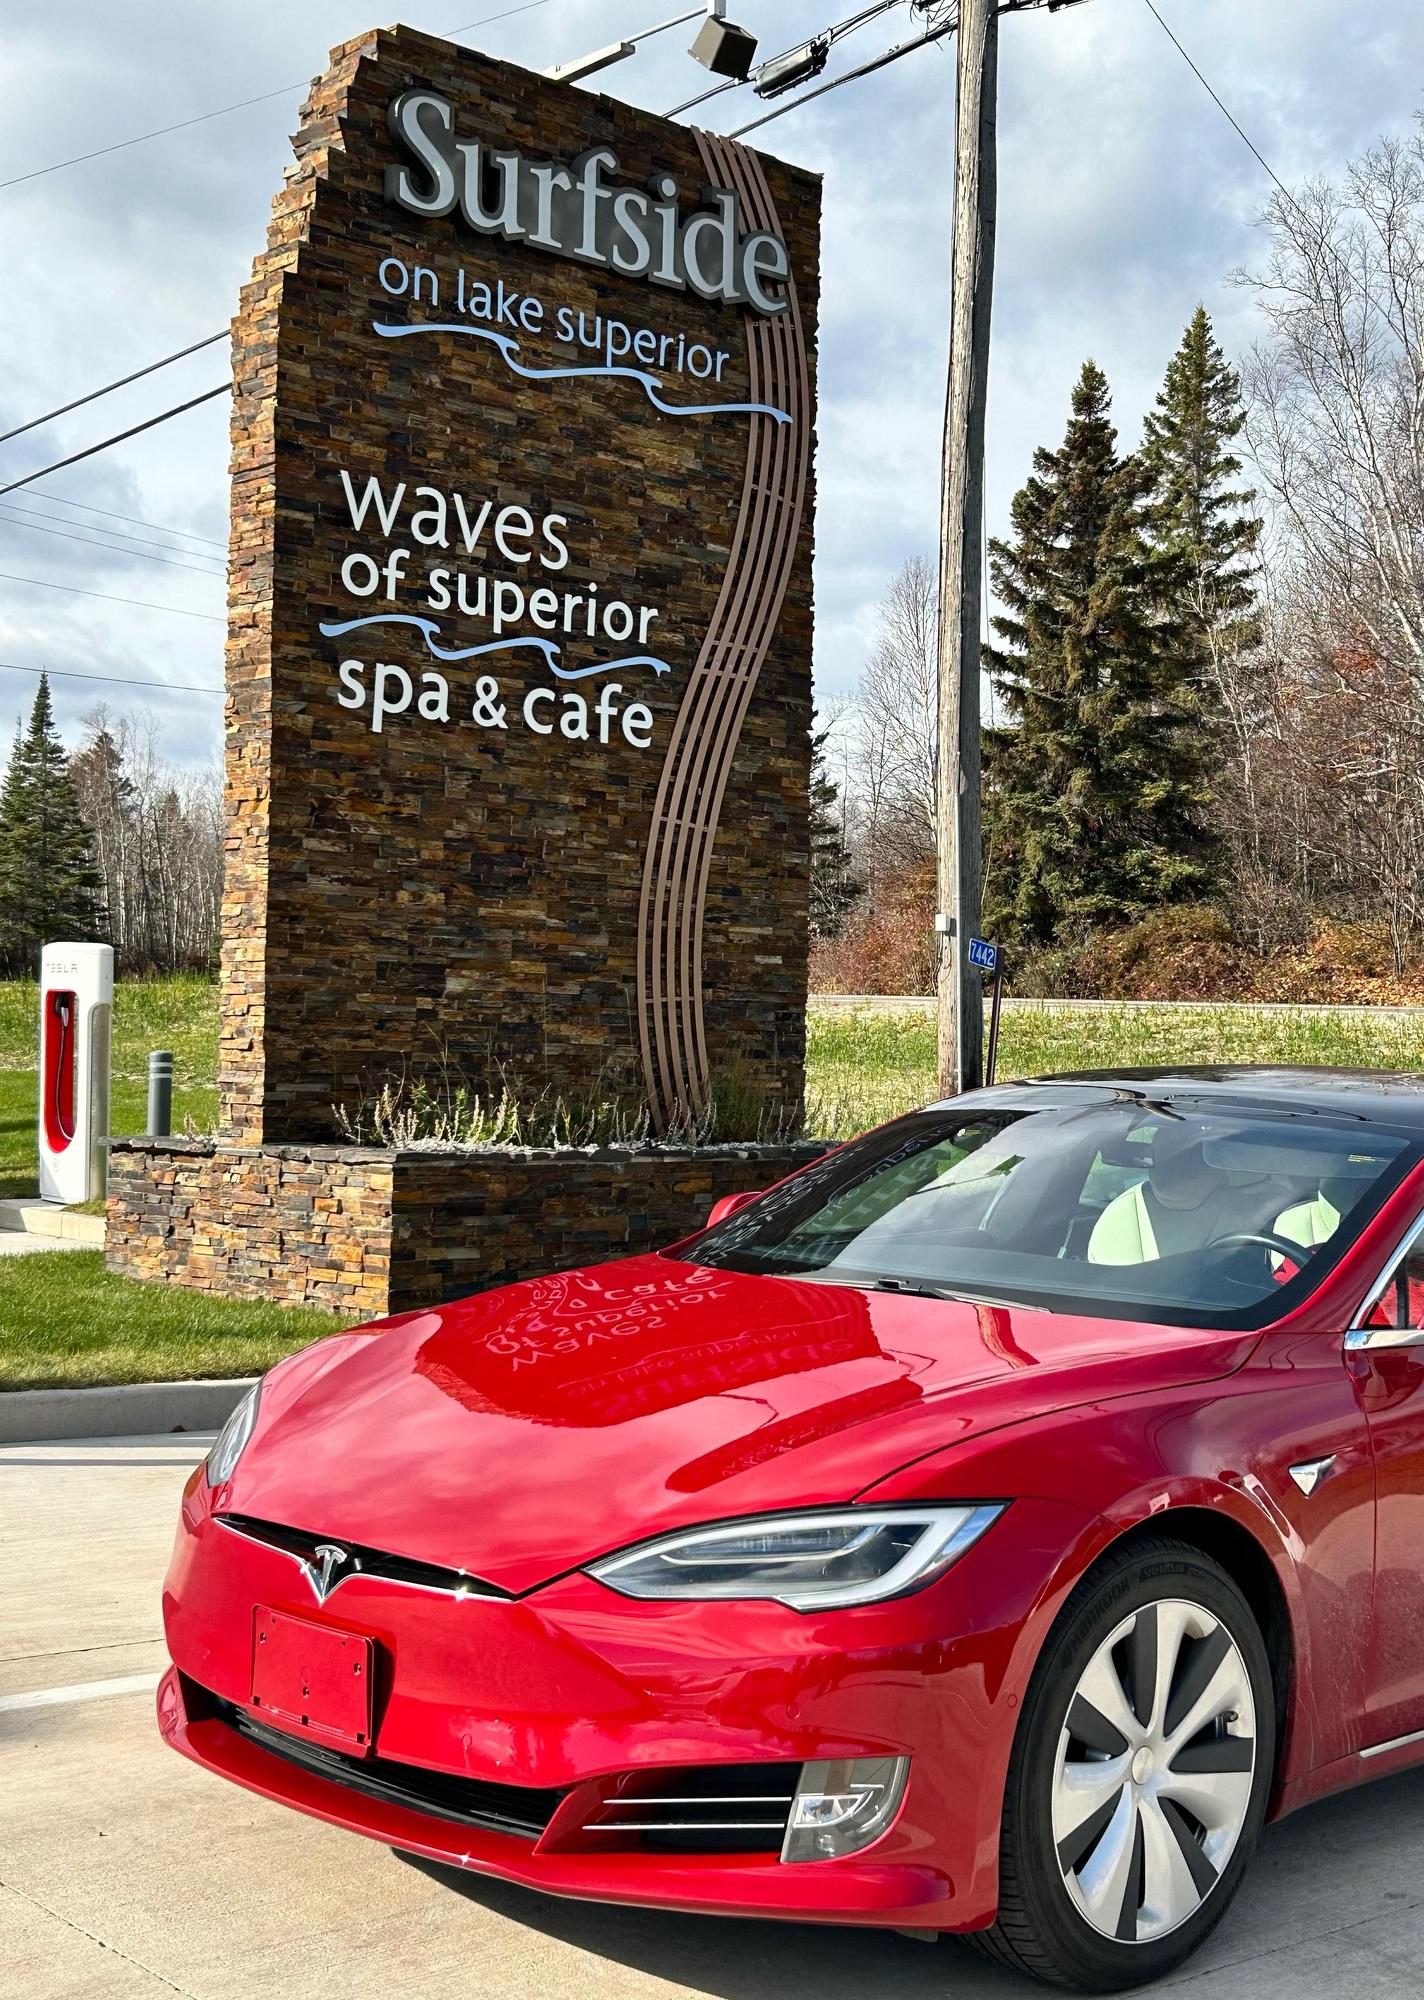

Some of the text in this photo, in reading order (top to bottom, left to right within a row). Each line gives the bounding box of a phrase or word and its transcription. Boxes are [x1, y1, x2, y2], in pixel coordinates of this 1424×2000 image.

[396, 93, 790, 313] Surfside
[378, 257, 730, 382] on lake superior
[340, 470, 569, 570] waves
[341, 549, 658, 644] of superior
[337, 659, 653, 748] spa & cafe
[971, 943, 994, 966] 7442
